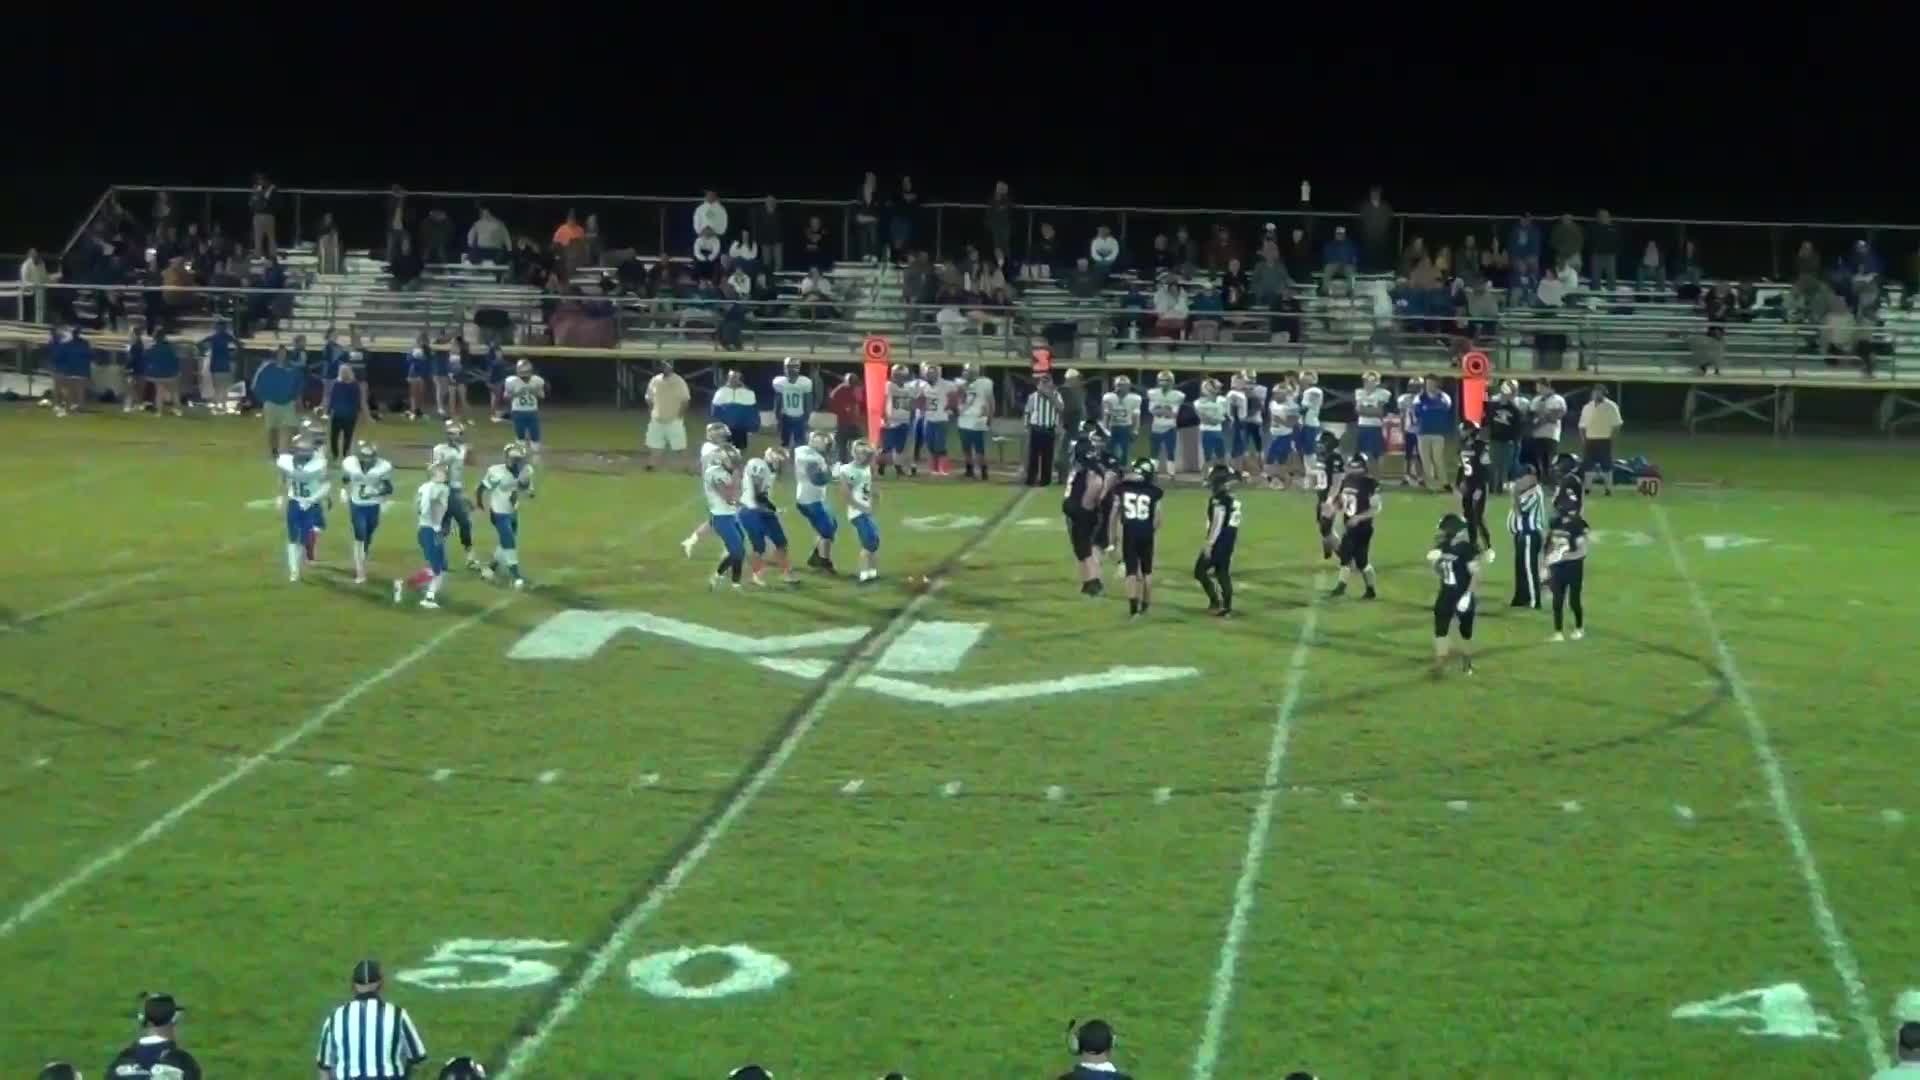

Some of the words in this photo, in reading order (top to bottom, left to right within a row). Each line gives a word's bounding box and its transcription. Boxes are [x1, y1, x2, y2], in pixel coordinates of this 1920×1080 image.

[785, 392, 800, 409] 10
[1637, 480, 1658, 497] 40
[1123, 492, 1151, 520] 56
